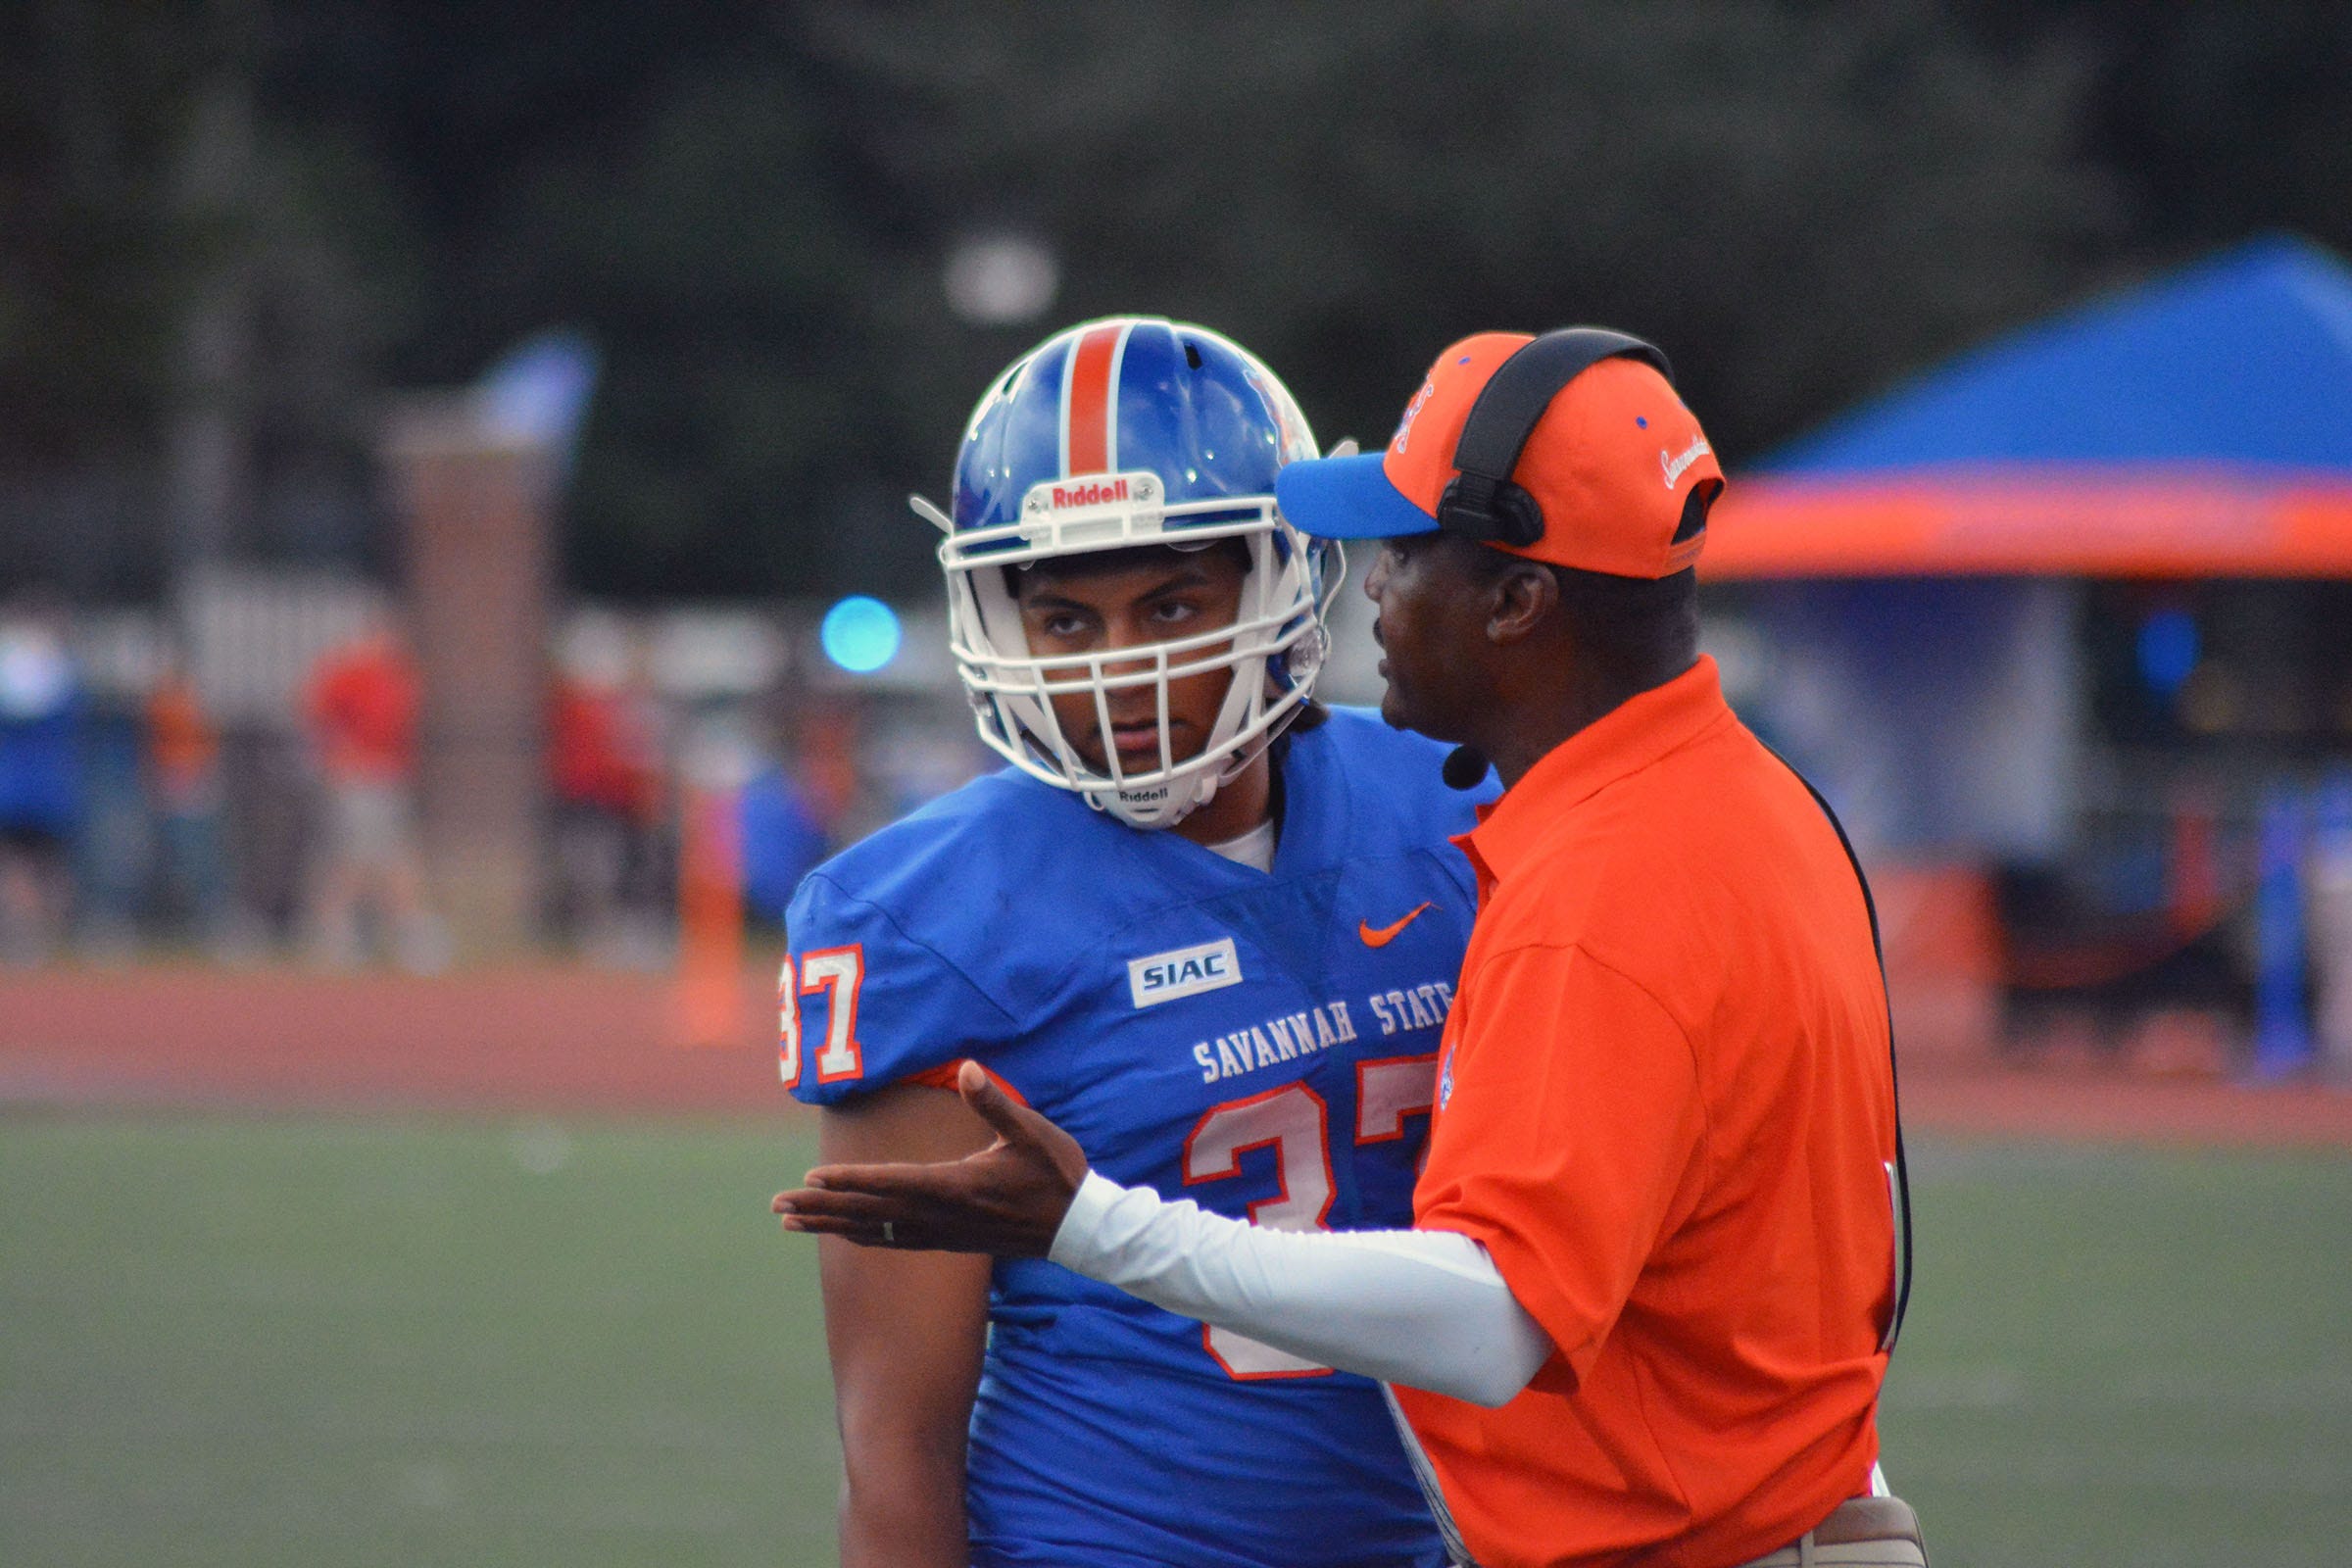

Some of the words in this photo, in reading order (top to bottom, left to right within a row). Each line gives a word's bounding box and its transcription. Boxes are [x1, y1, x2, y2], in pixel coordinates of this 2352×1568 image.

[1052, 479, 1128, 509] Riddell
[1119, 787, 1168, 803] Riddell
[1143, 953, 1226, 992] SIAC
[1193, 1001, 1357, 1084] SAVANNAH
[1369, 983, 1454, 1035] STATE
